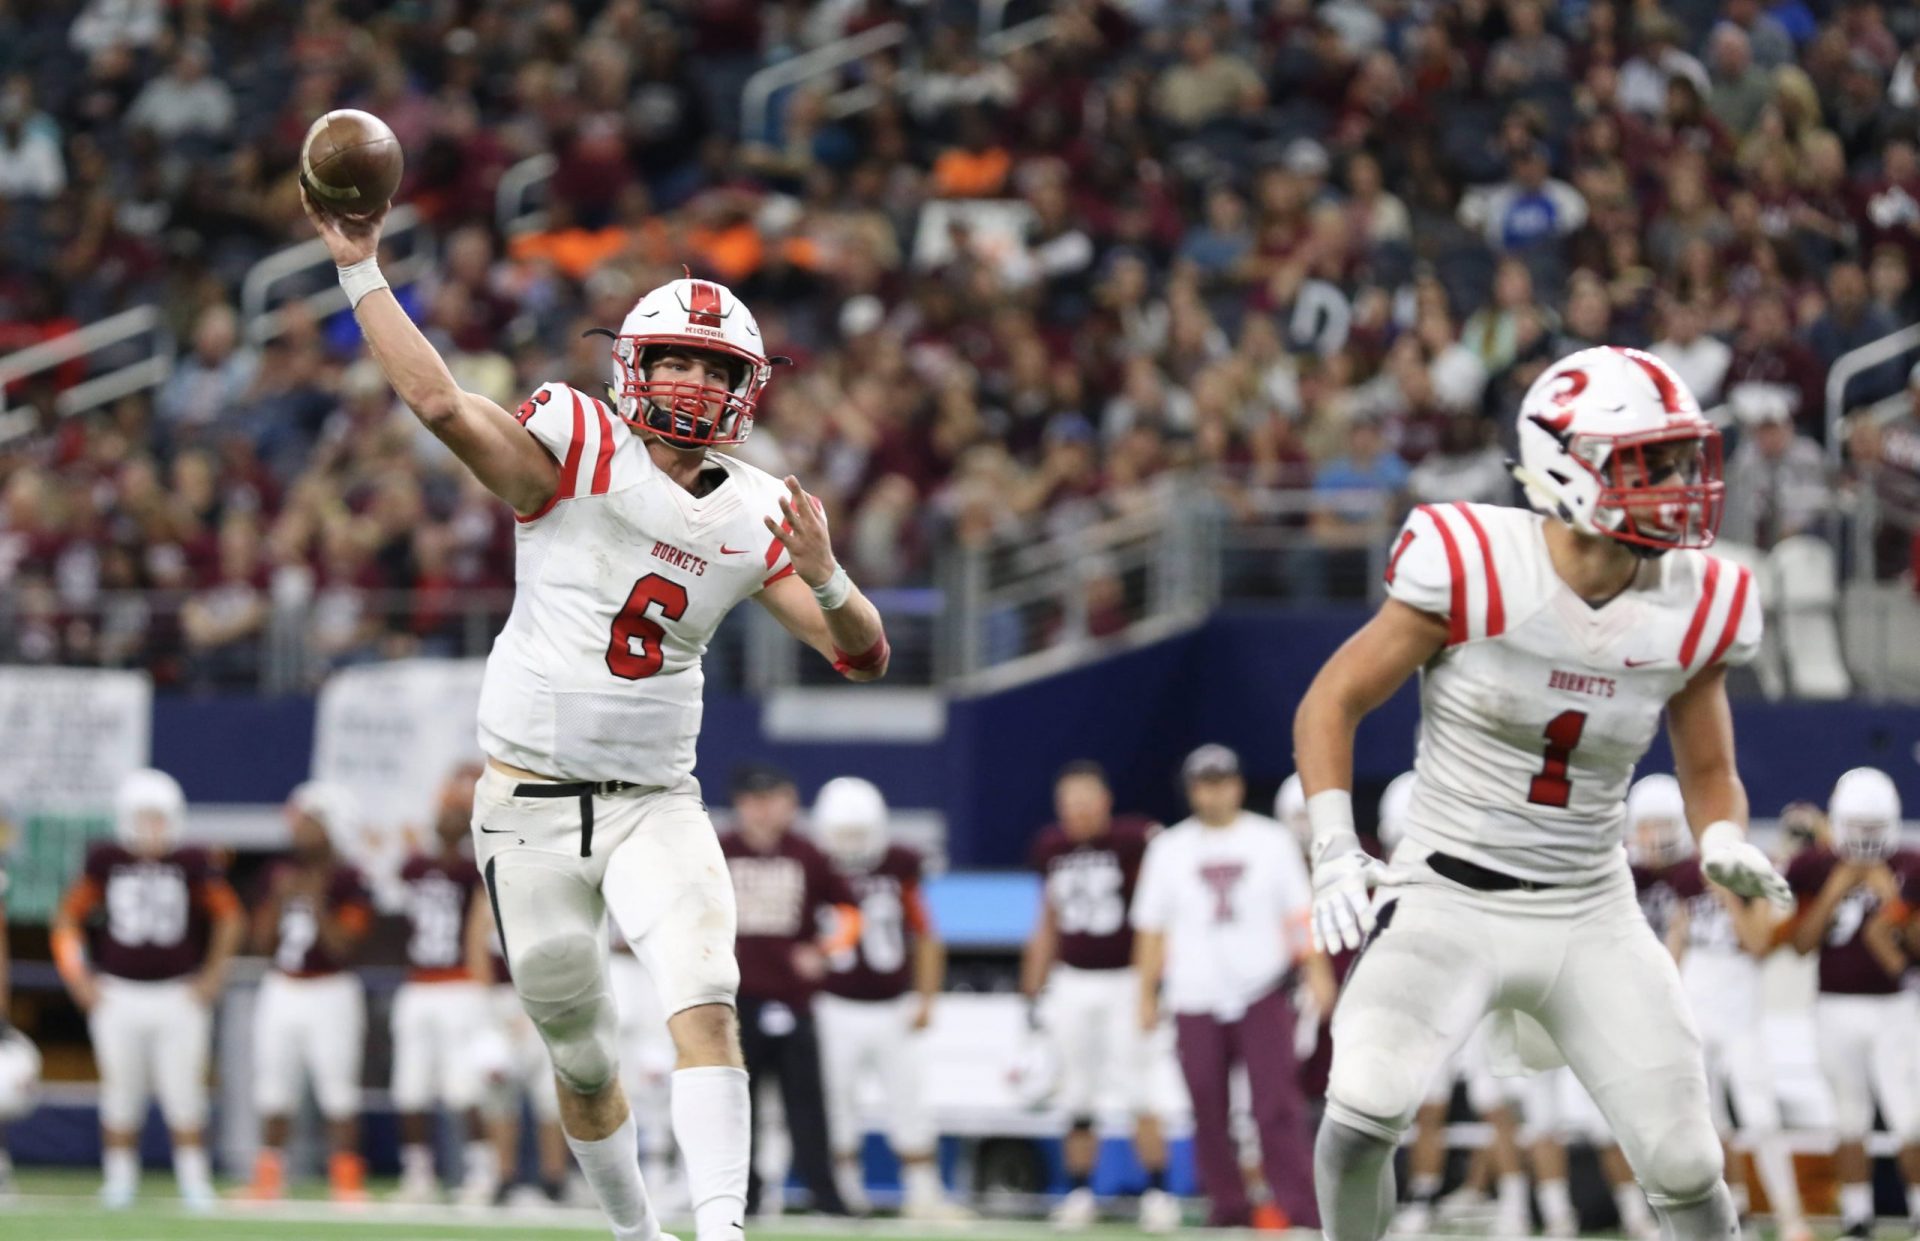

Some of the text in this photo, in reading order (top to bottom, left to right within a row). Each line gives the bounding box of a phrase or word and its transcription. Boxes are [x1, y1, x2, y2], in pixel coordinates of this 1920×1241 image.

[651, 541, 707, 576] HORNETS
[605, 572, 689, 680] 6
[1548, 670, 1616, 698] HORNETS
[1527, 709, 1588, 808] 1
